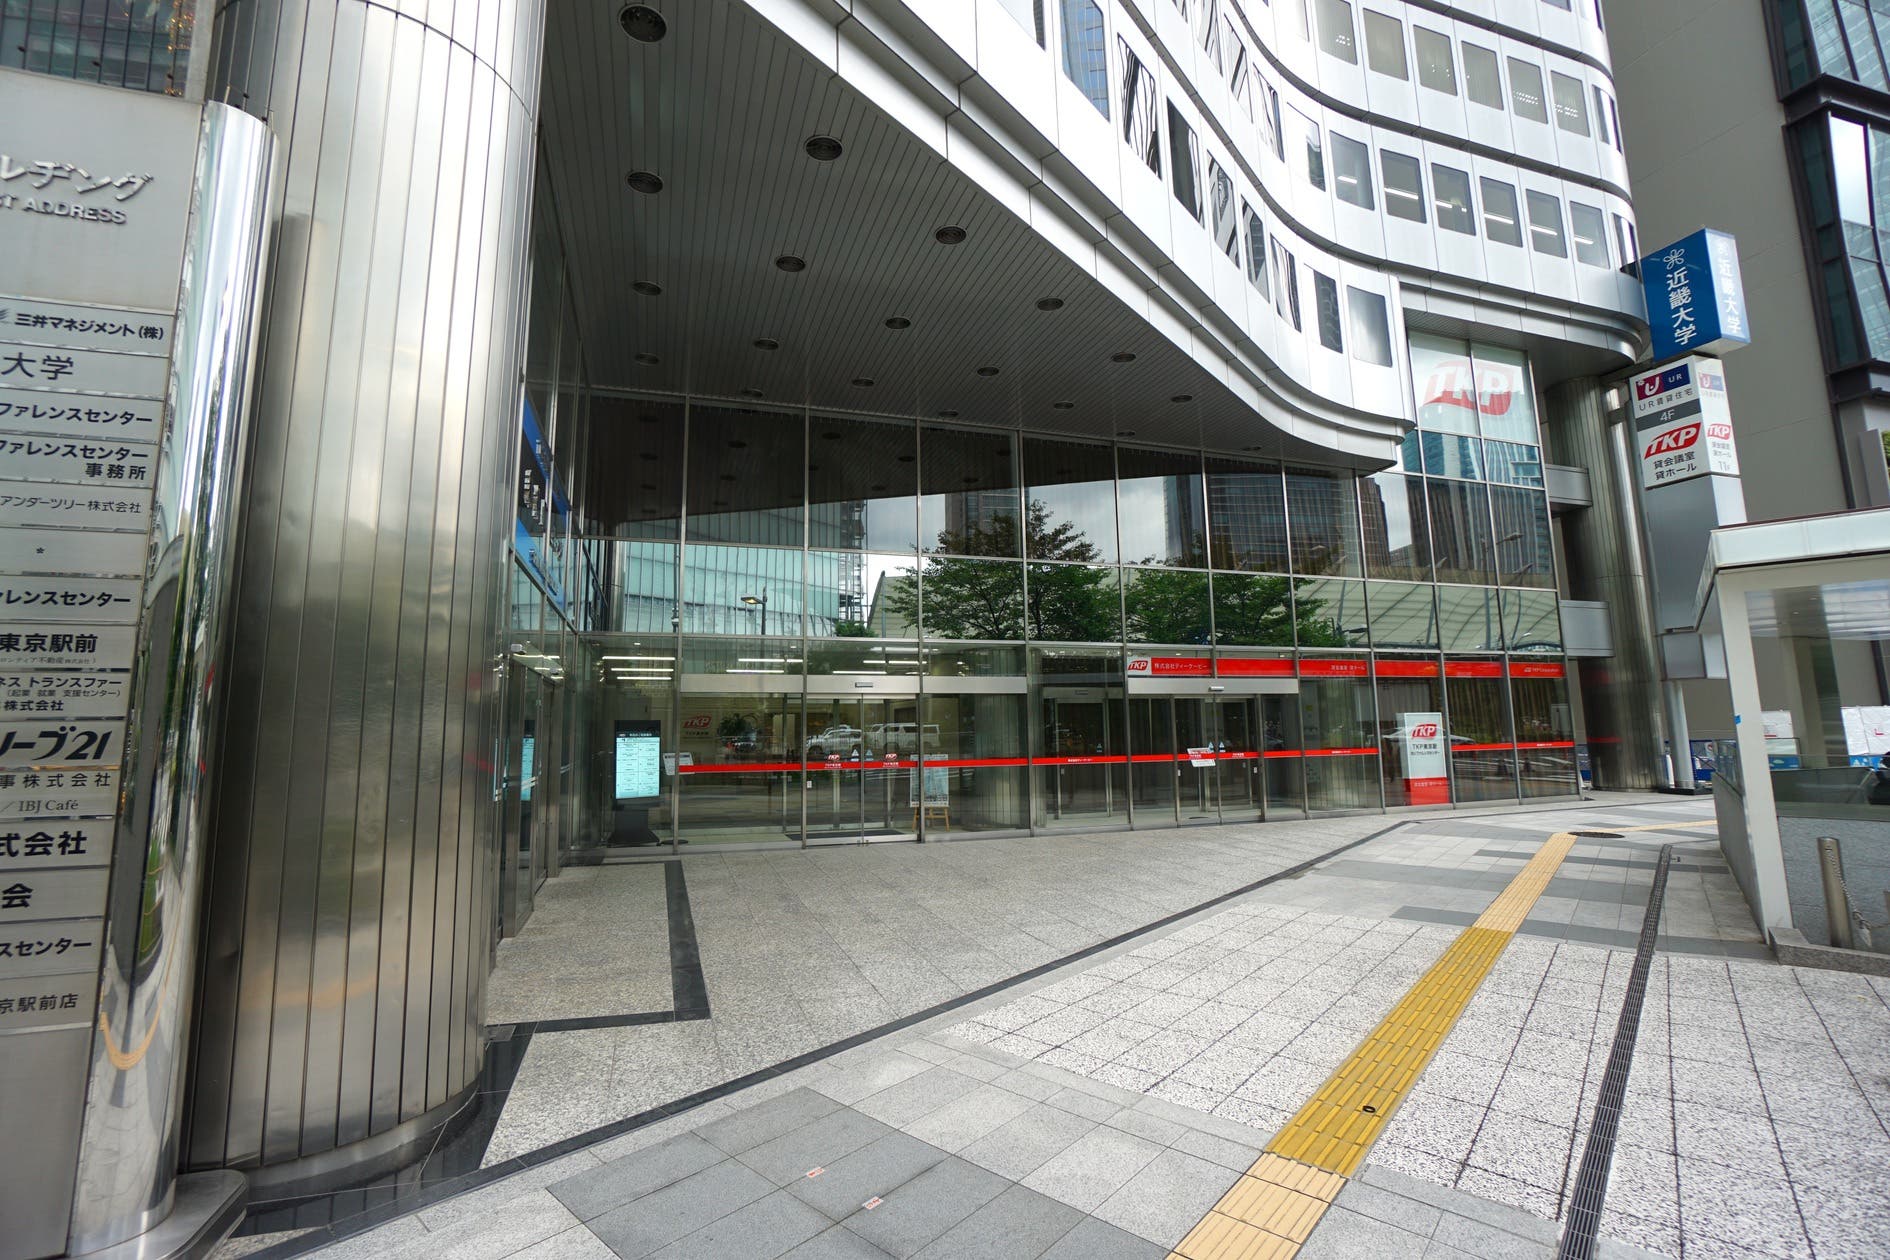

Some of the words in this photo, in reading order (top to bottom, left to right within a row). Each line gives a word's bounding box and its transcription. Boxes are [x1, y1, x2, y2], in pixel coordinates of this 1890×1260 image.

[23, 198, 127, 225] ADDRESS
[1665, 266, 1698, 346] 近畿大学
[1, 352, 74, 380] 大学
[1432, 366, 1511, 406] TKP
[1668, 373, 1683, 383] UR
[1638, 388, 1694, 411] UR賃貸住宅
[0, 402, 153, 425] ファレンスセンター
[1660, 409, 1676, 421] 4F
[1648, 426, 1697, 455] TKP
[1708, 426, 1730, 437] TKP
[1653, 451, 1696, 469] 貸会議室
[85, 463, 147, 480] 事務所
[1655, 463, 1698, 481] 貸ホール
[0, 495, 142, 514] アンダーツリー株式会社
[0, 589, 131, 608] レンスセンター
[0, 633, 98, 654] 東京駅前
[1129, 661, 1147, 671] TKP
[29, 676, 122, 688] トランスファー
[4, 700, 64, 711] 株式会社
[1413, 725, 1436, 737] TKP
[0, 773, 111, 789] 事株式会社
[18, 800, 41, 814] IBJ
[45, 799, 79, 811] Café
[0, 830, 87, 858] 式会社
[2, 883, 33, 909] 会
[0, 937, 92, 957] スセンター
[0, 993, 79, 1015] 京駅前店
